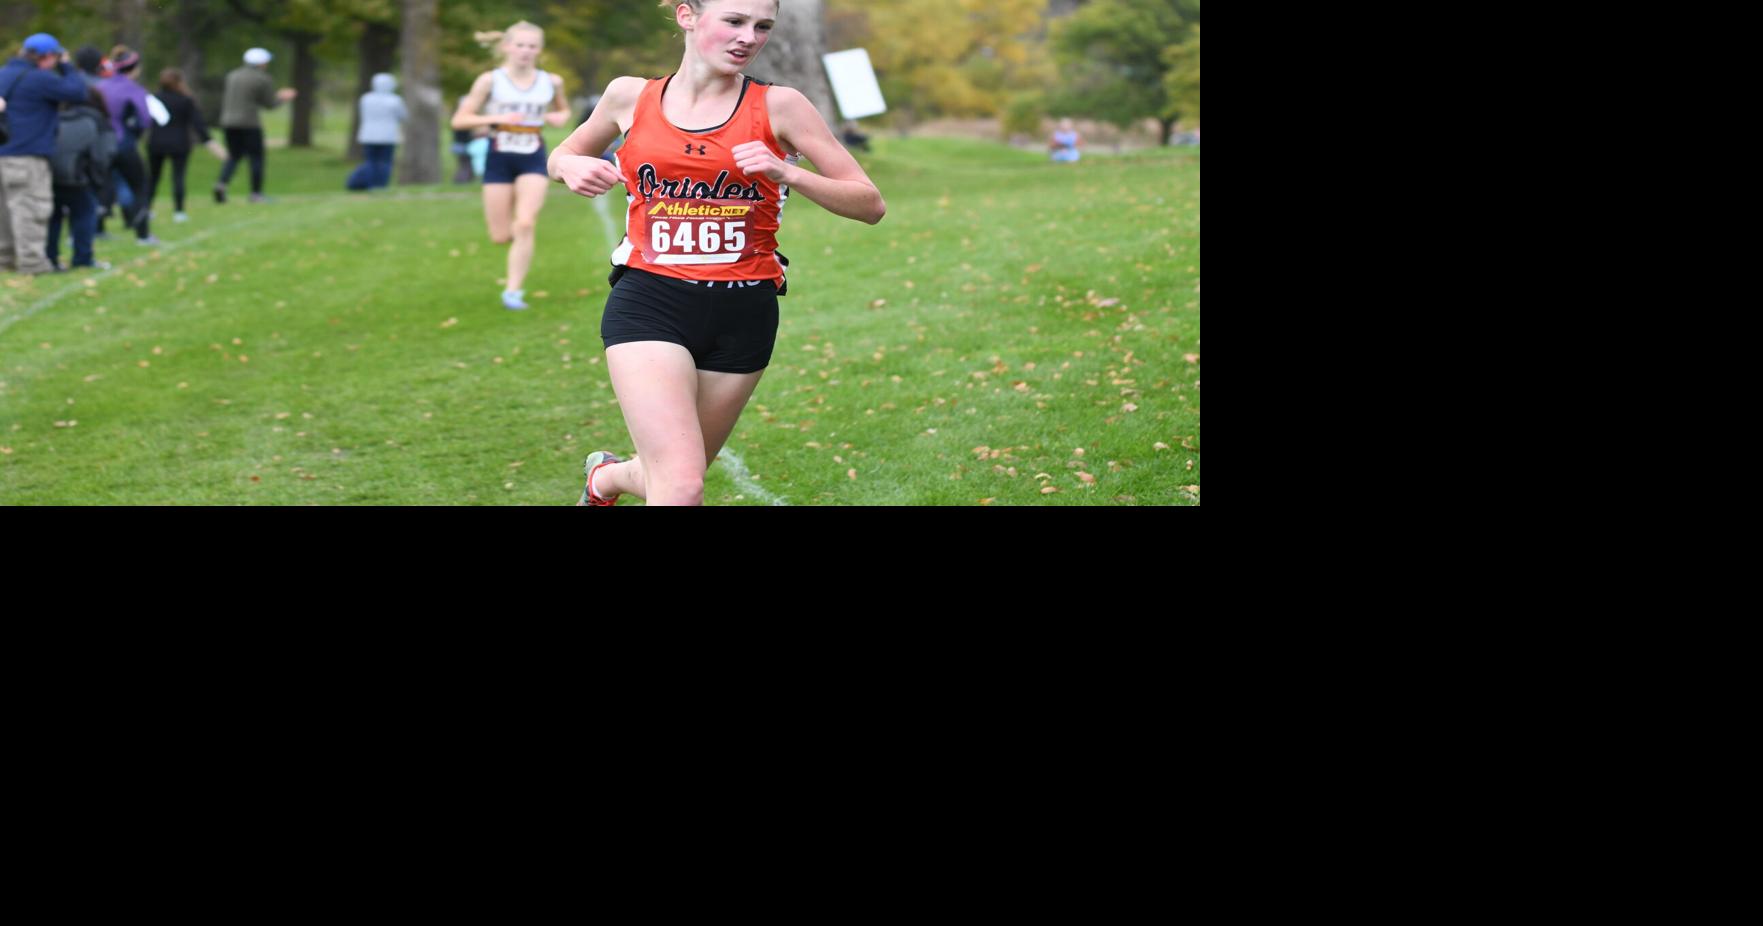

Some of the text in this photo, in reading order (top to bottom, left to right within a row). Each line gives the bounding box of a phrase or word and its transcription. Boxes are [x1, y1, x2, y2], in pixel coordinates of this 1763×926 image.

[637, 163, 766, 201] Orioles
[647, 201, 721, 216] Athletic
[651, 221, 746, 253] 6465
